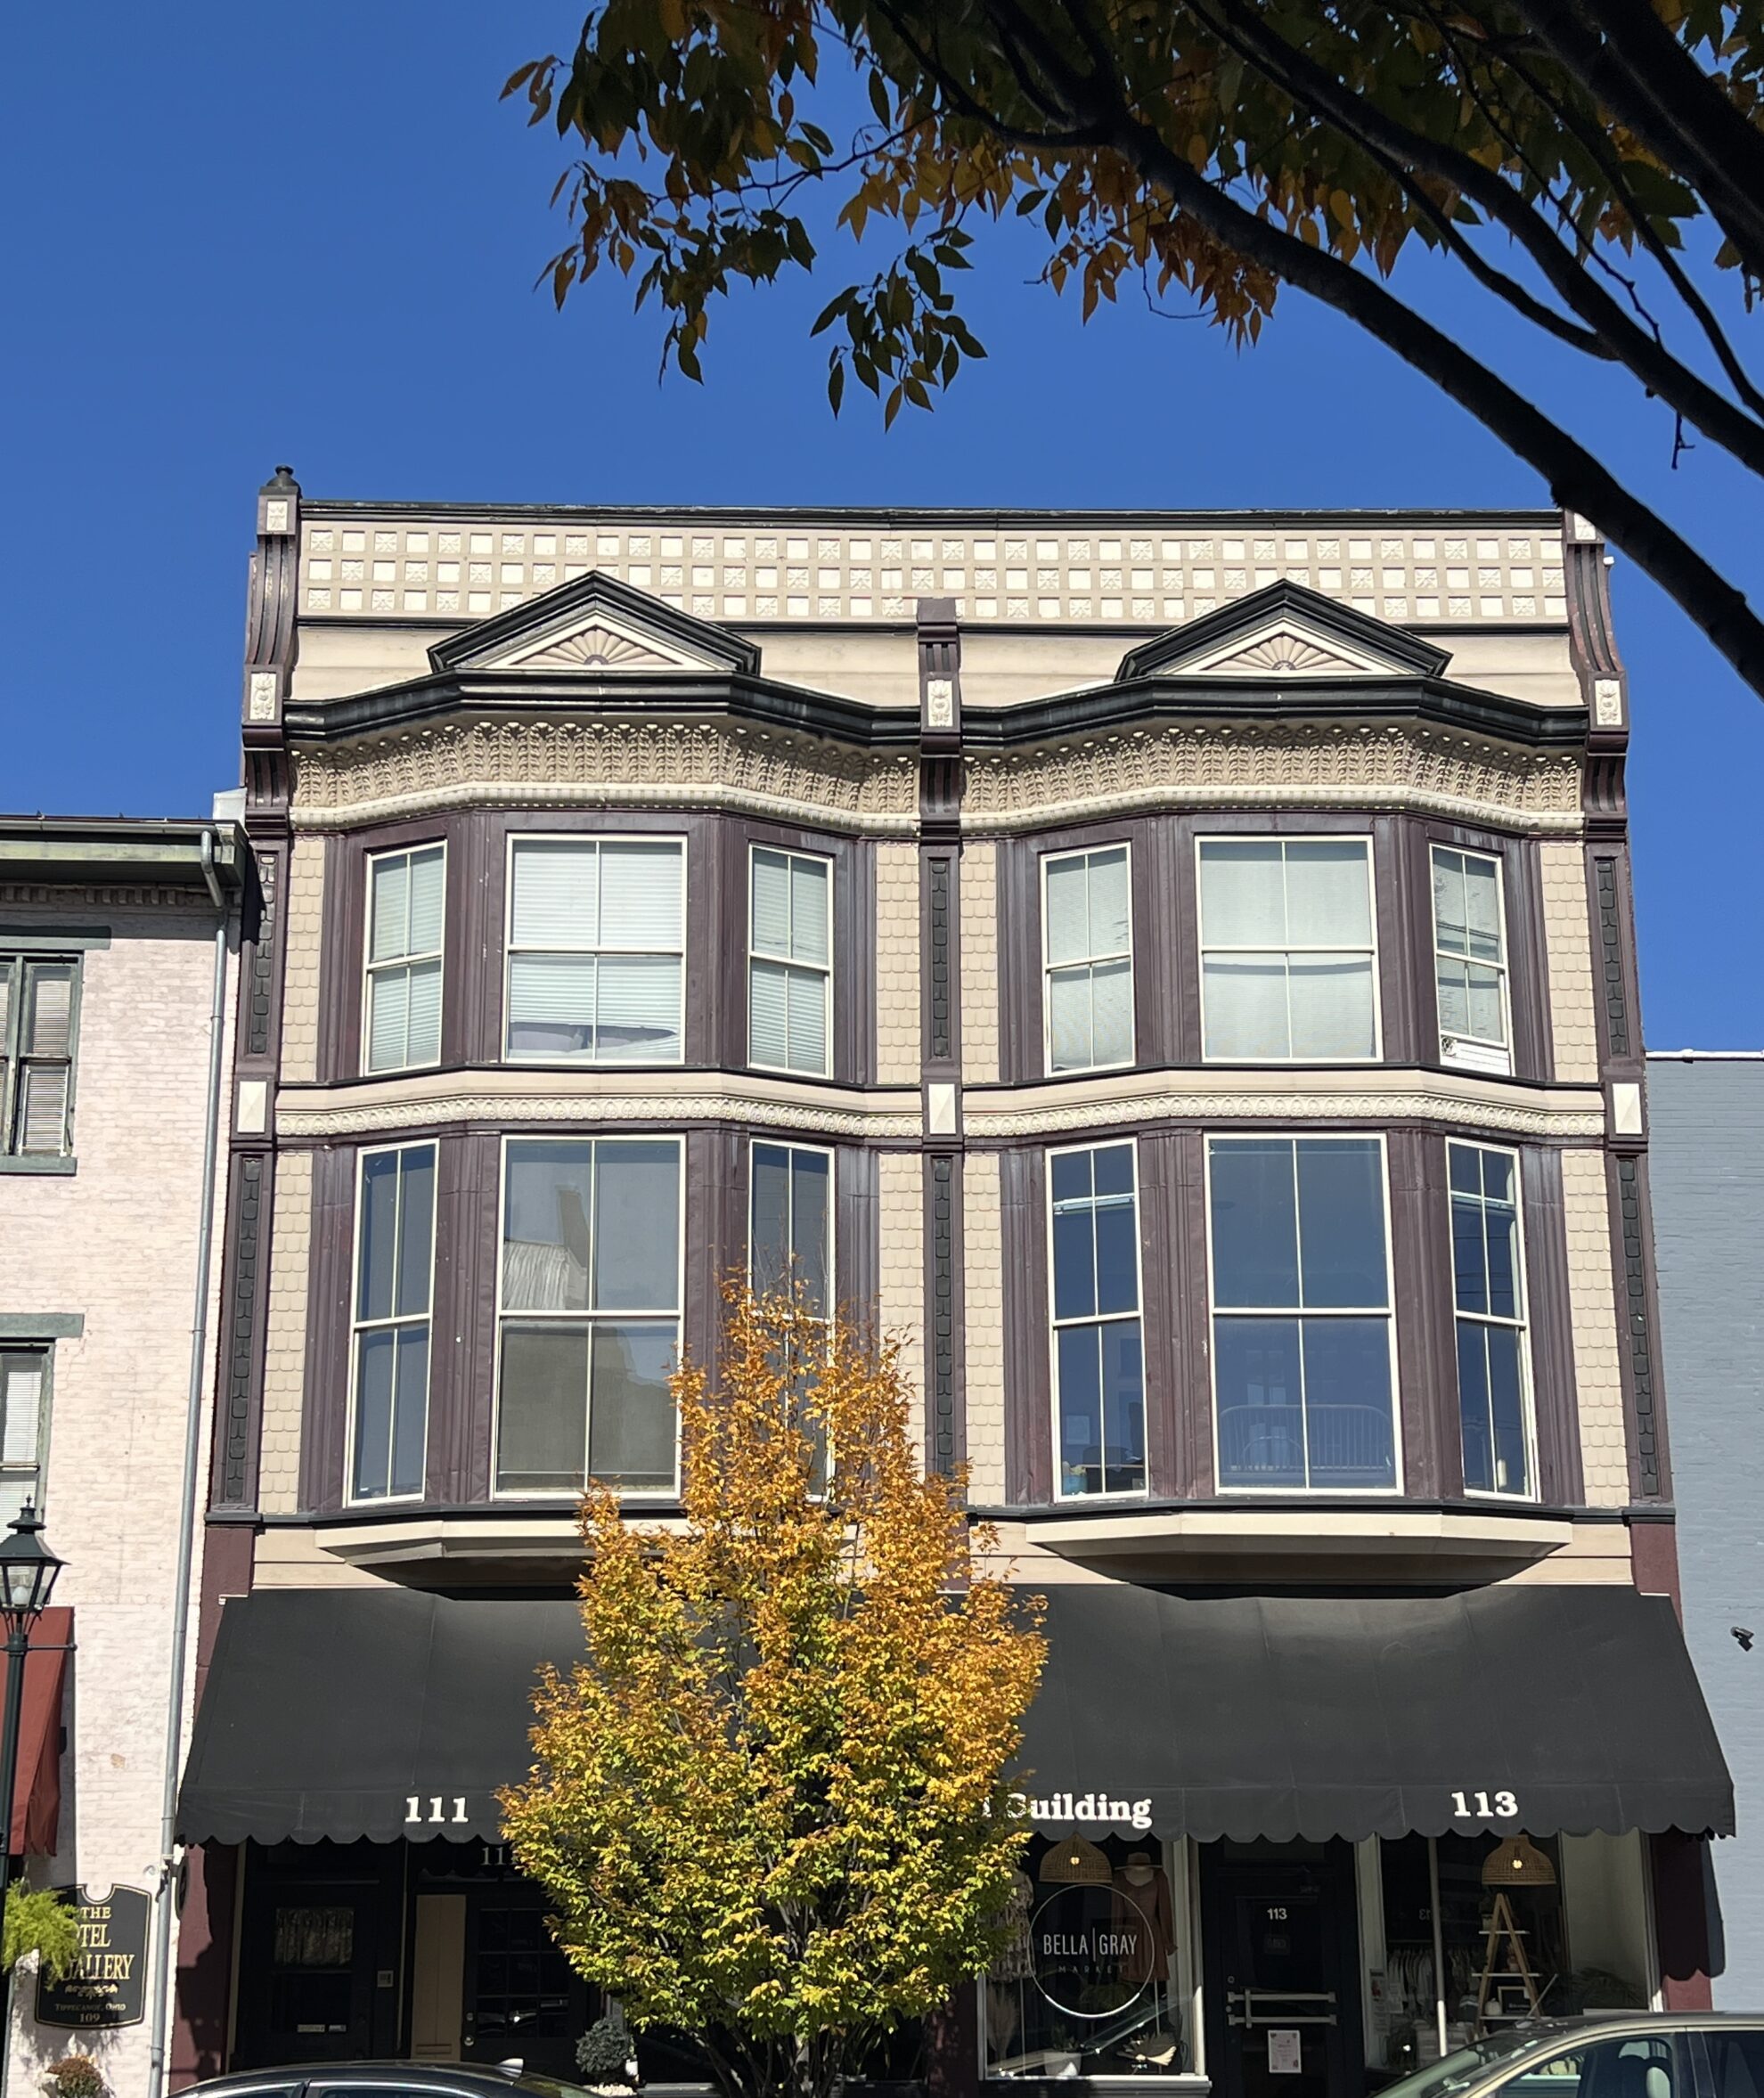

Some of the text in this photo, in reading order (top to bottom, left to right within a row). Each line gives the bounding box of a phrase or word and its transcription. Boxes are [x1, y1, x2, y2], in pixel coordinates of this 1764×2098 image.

[404, 1796, 469, 1822] 111
[1451, 1791, 1519, 1817] 113
[80, 1906, 111, 1920] THE
[1266, 1907, 1288, 1921] 113
[77, 1923, 111, 1947] TEL
[1043, 1934, 1137, 1955] BELLA GRAY
[1058, 1964, 1124, 1974] MARKET
[79, 2012, 101, 2023] 109
